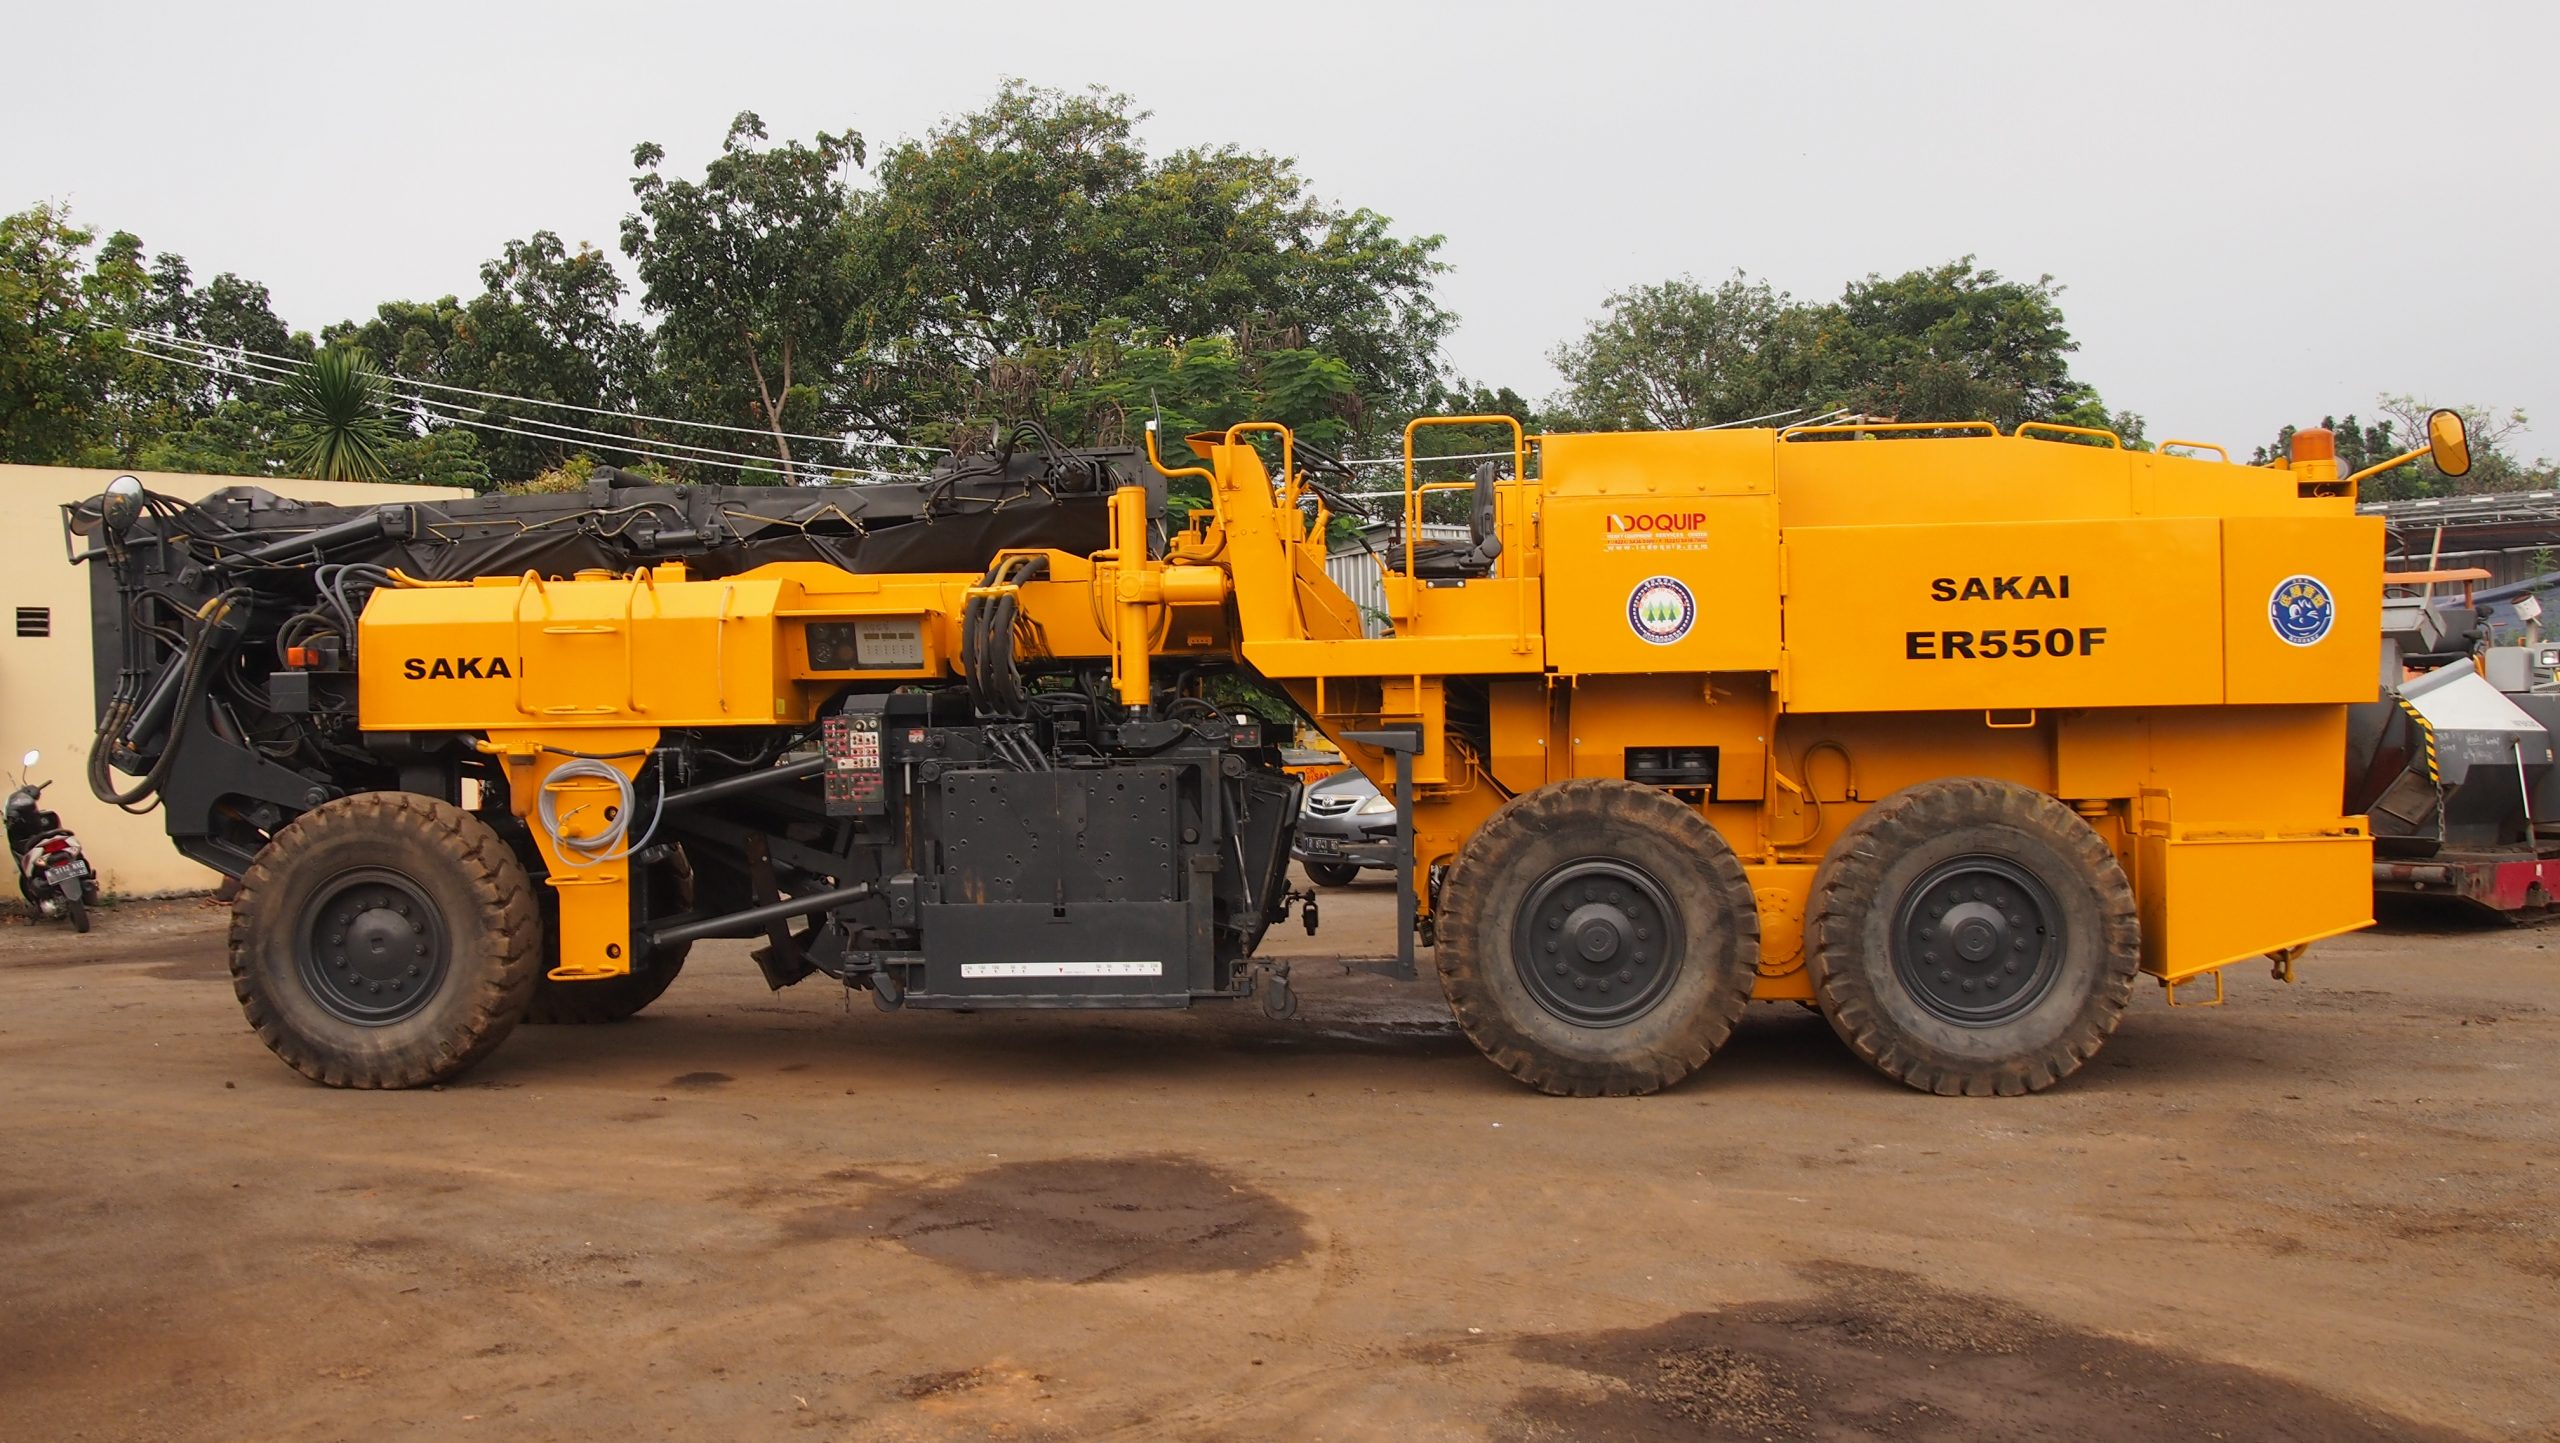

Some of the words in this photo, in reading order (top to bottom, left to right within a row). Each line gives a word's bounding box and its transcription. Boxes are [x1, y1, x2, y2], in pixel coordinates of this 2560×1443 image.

[1606, 513, 1706, 532] INDOQUIP
[1930, 575, 2070, 602] SAKAI
[1905, 626, 2108, 660] ER550F
[403, 656, 523, 681] SAKA
